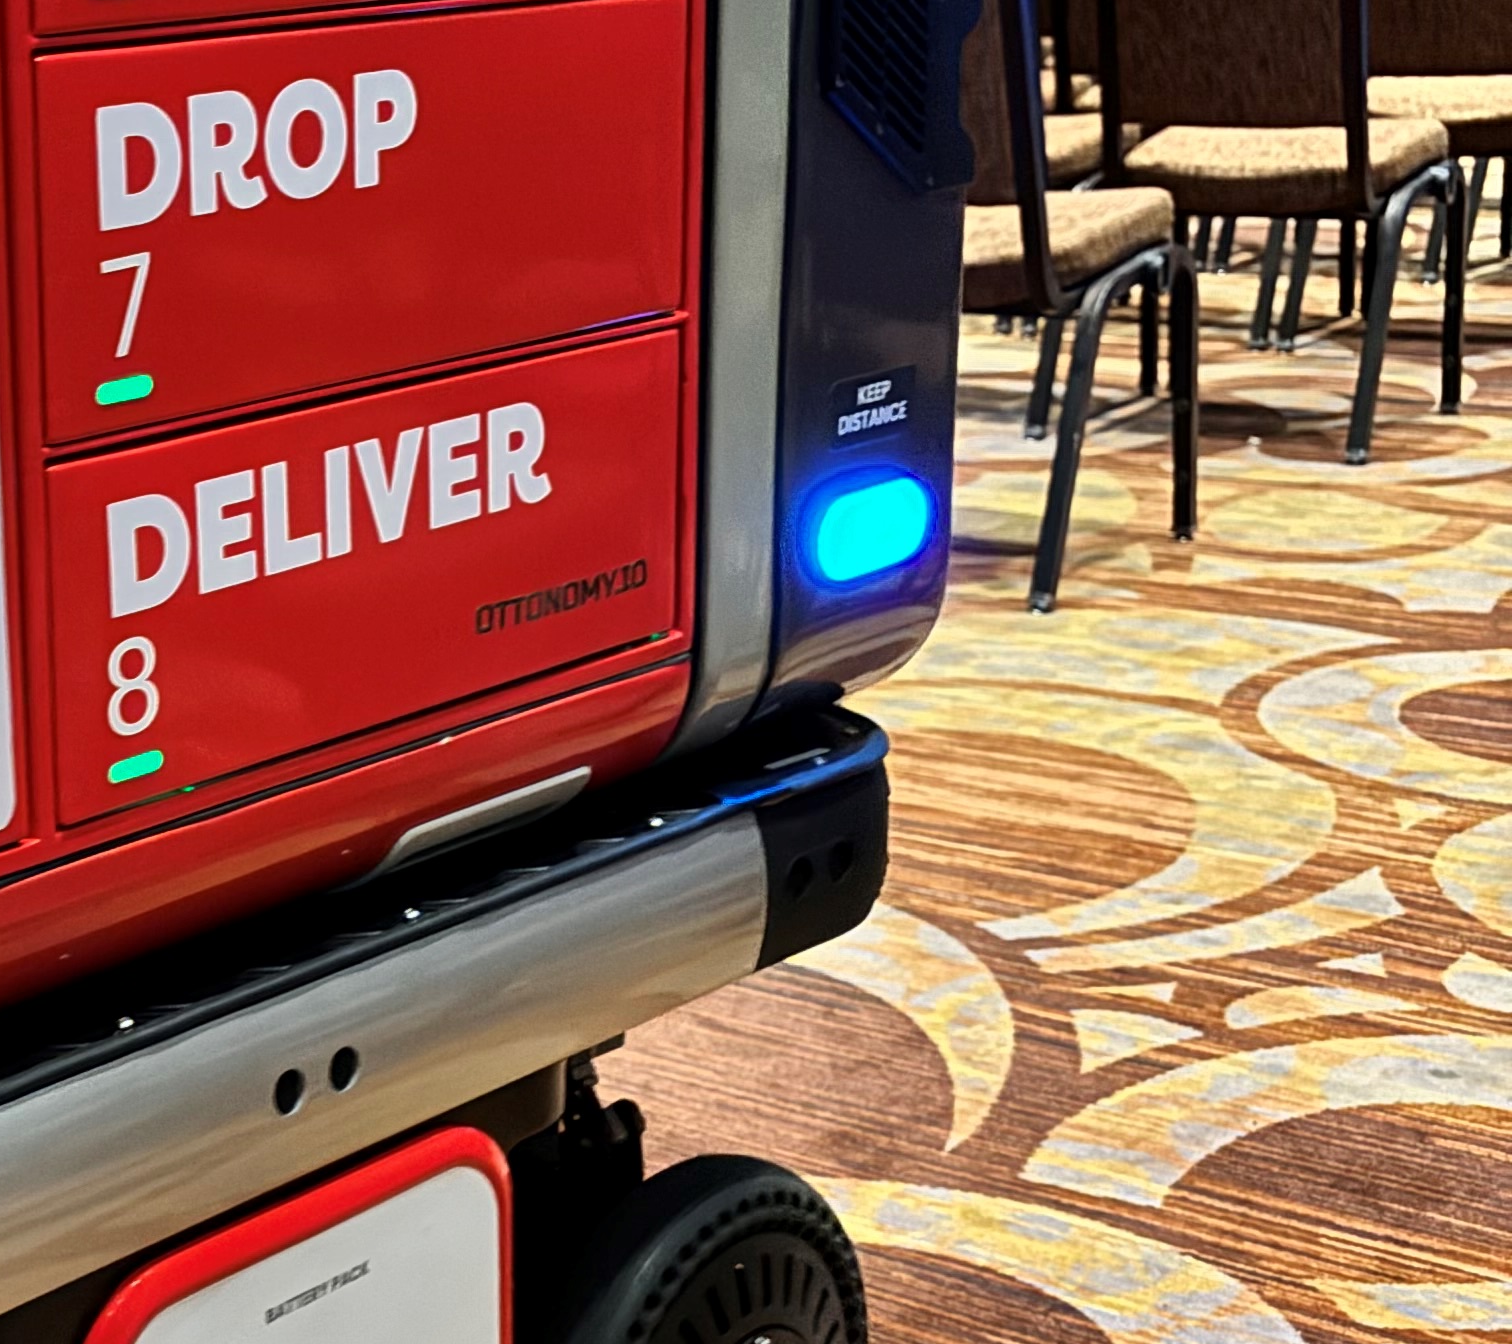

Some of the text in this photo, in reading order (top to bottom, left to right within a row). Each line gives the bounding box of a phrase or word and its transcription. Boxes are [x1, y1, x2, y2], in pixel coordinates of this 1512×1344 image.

[95, 69, 418, 231] DROP
[99, 251, 152, 358] 7
[838, 400, 908, 436] DISTANCE
[856, 379, 892, 406] KEEP
[105, 401, 553, 619] DELIVER
[475, 558, 649, 635] OTTONOMY.IO
[107, 635, 160, 737] 8
[264, 1258, 371, 1326] BATTERY PACK
